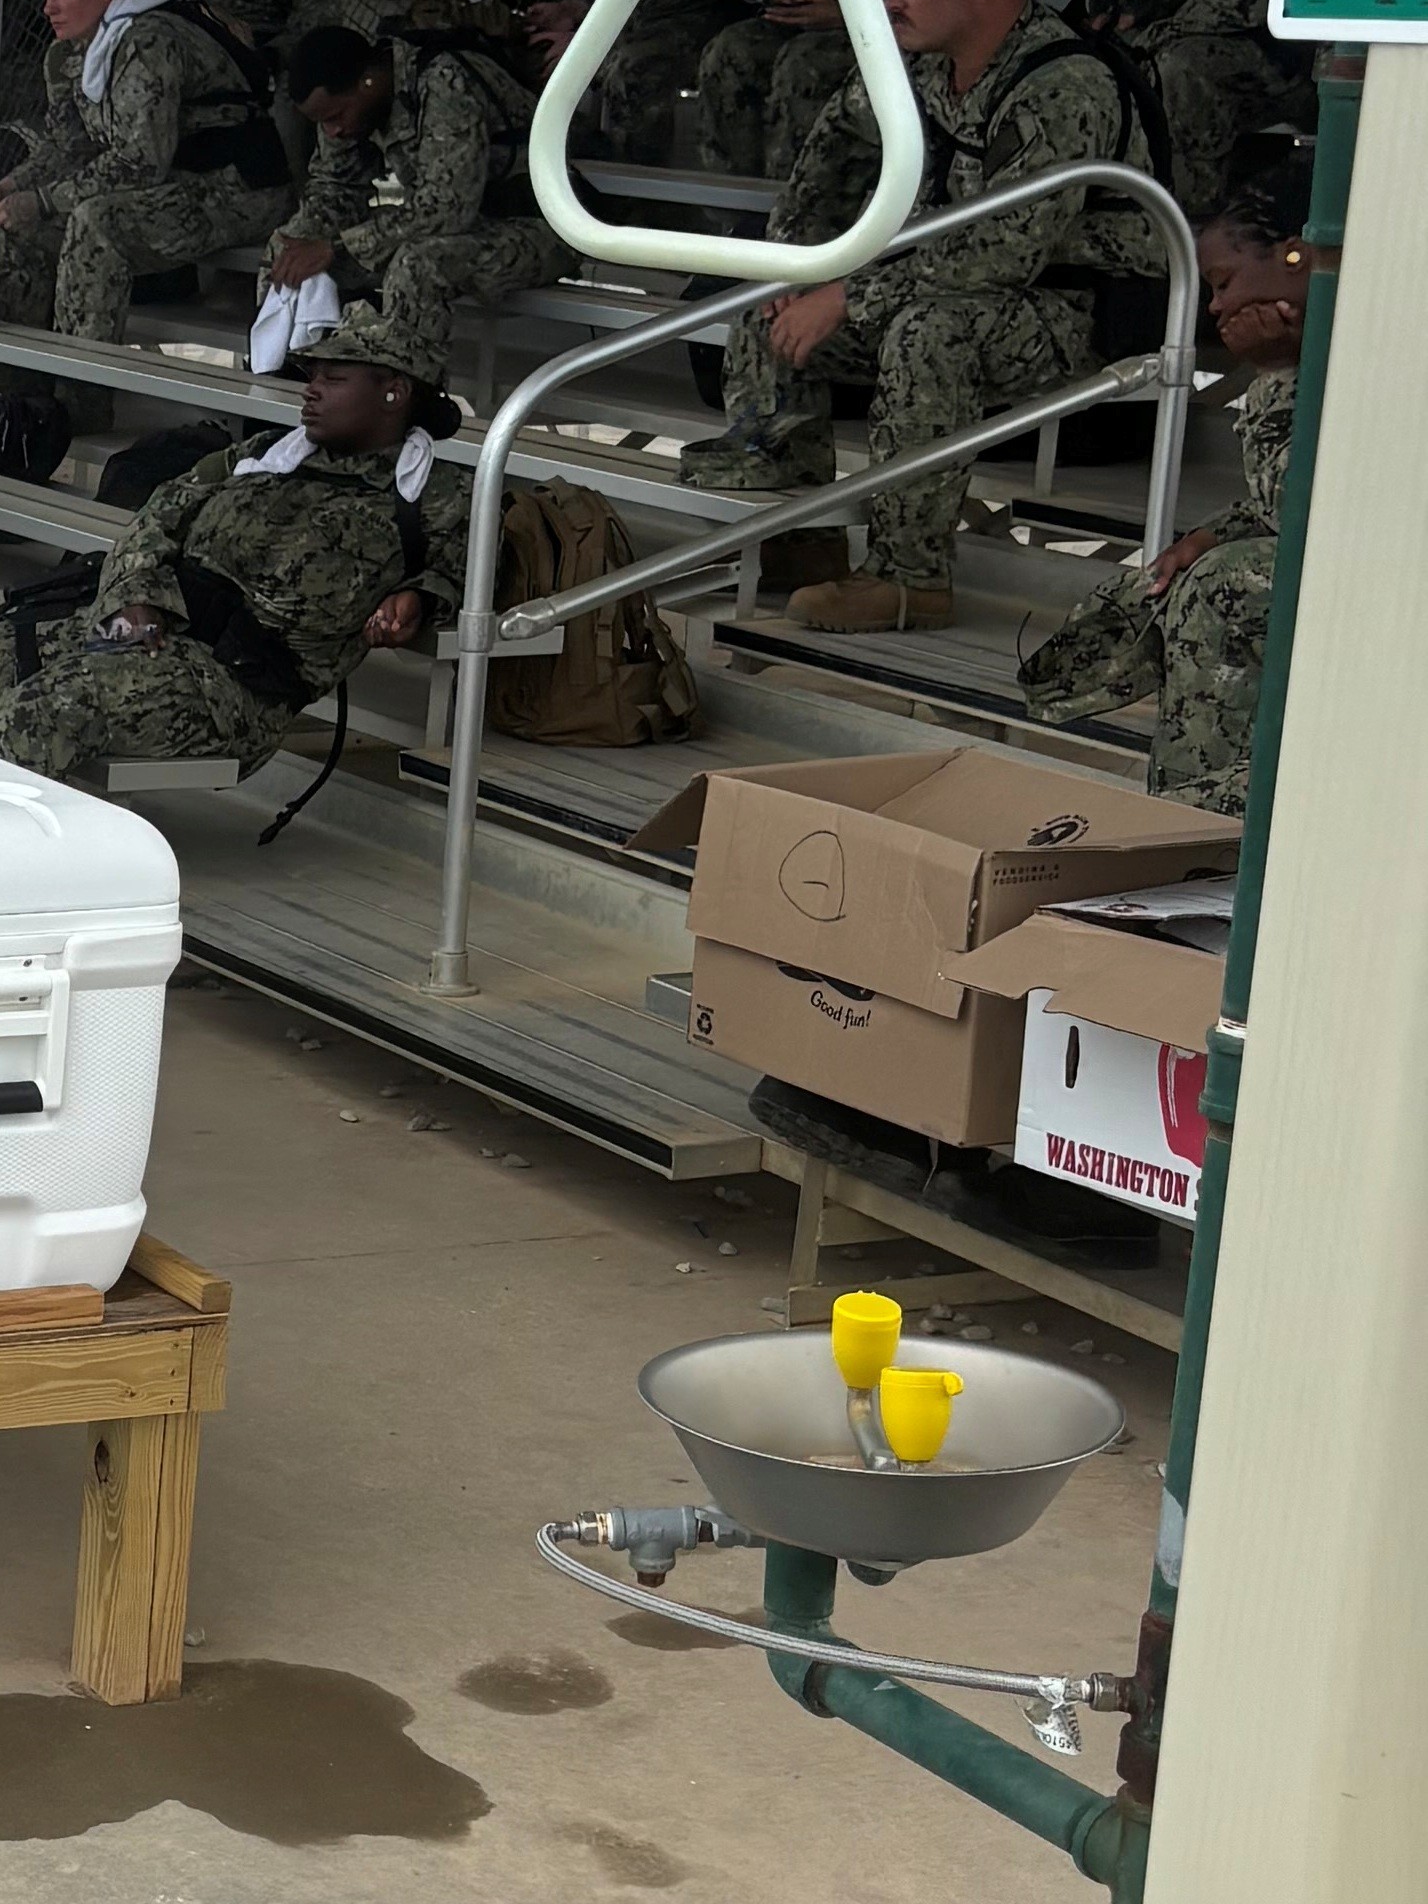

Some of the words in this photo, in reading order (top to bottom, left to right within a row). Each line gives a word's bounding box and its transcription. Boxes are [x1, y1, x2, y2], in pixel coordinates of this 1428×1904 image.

[810, 990, 843, 1022] Good
[843, 1008, 872, 1030] fun!
[1046, 1132, 1190, 1207] WASHINGTON
